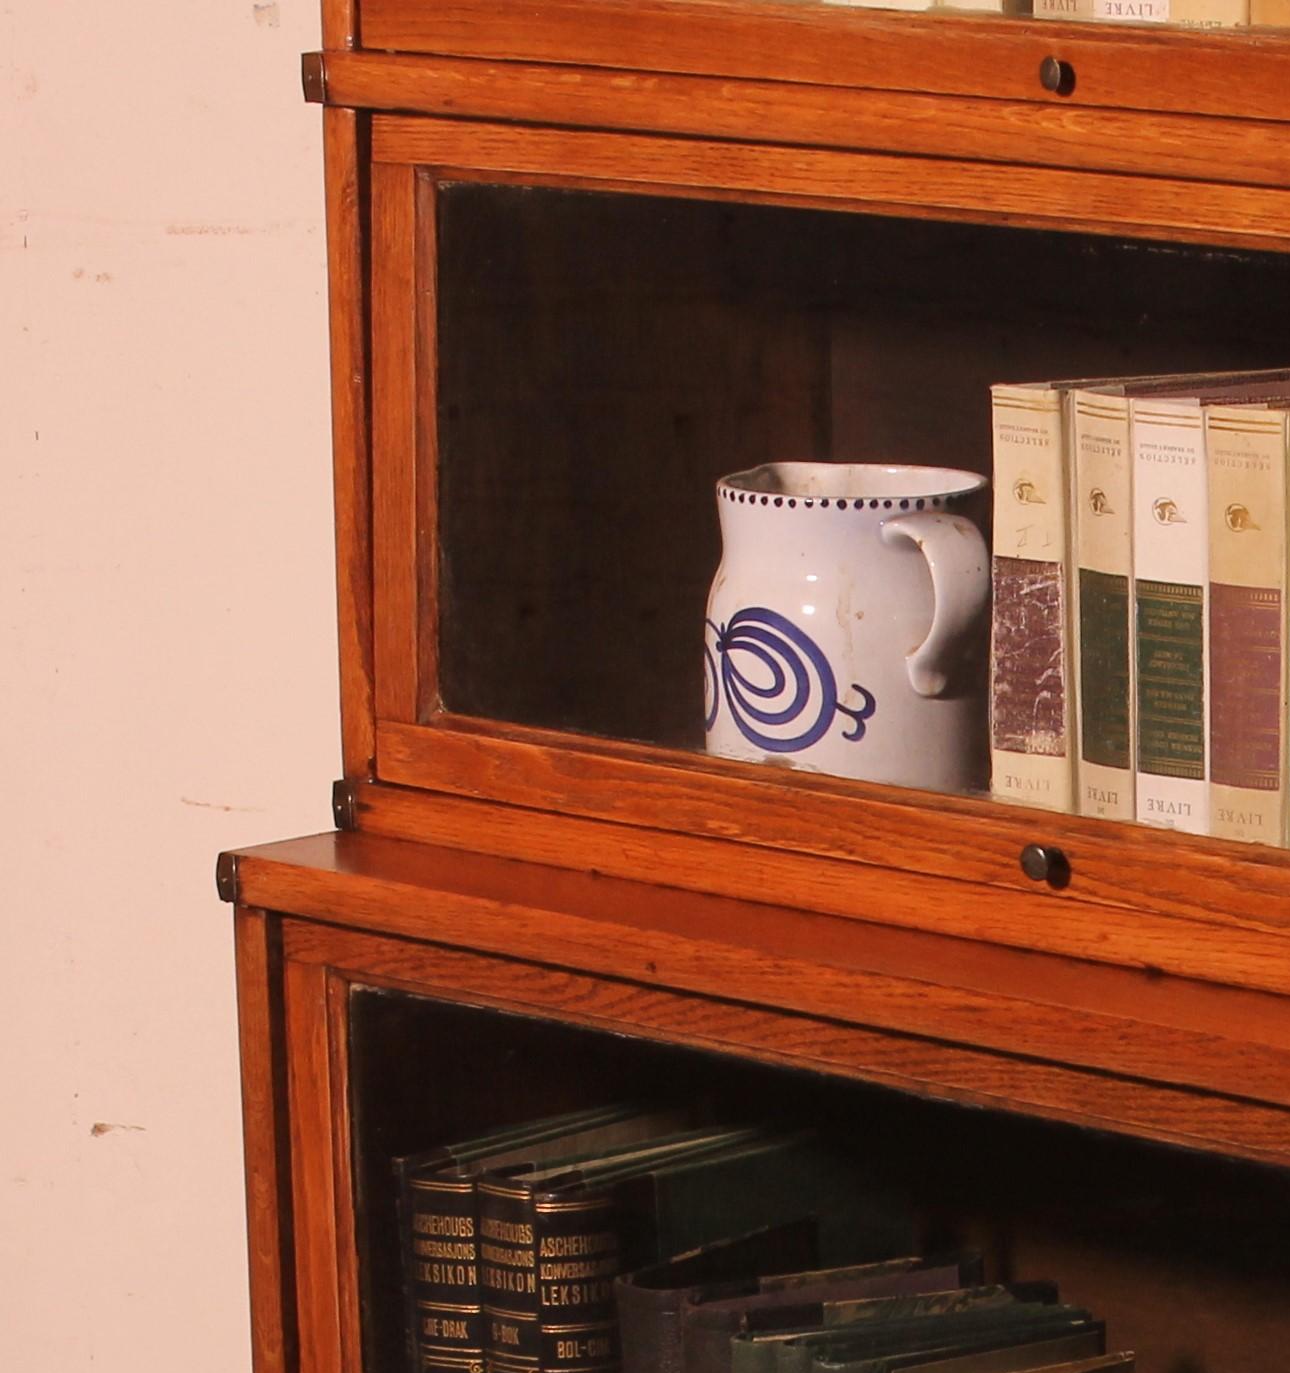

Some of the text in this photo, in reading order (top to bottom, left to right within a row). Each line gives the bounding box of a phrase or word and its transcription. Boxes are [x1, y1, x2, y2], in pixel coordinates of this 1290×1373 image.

[1105, 2, 1153, 16] LIVRE
[1005, 775, 1050, 791] LIVRE
[1087, 786, 1118, 805] LIVRE
[1147, 798, 1191, 816] LIVRE
[1218, 808, 1263, 825] LIVRE
